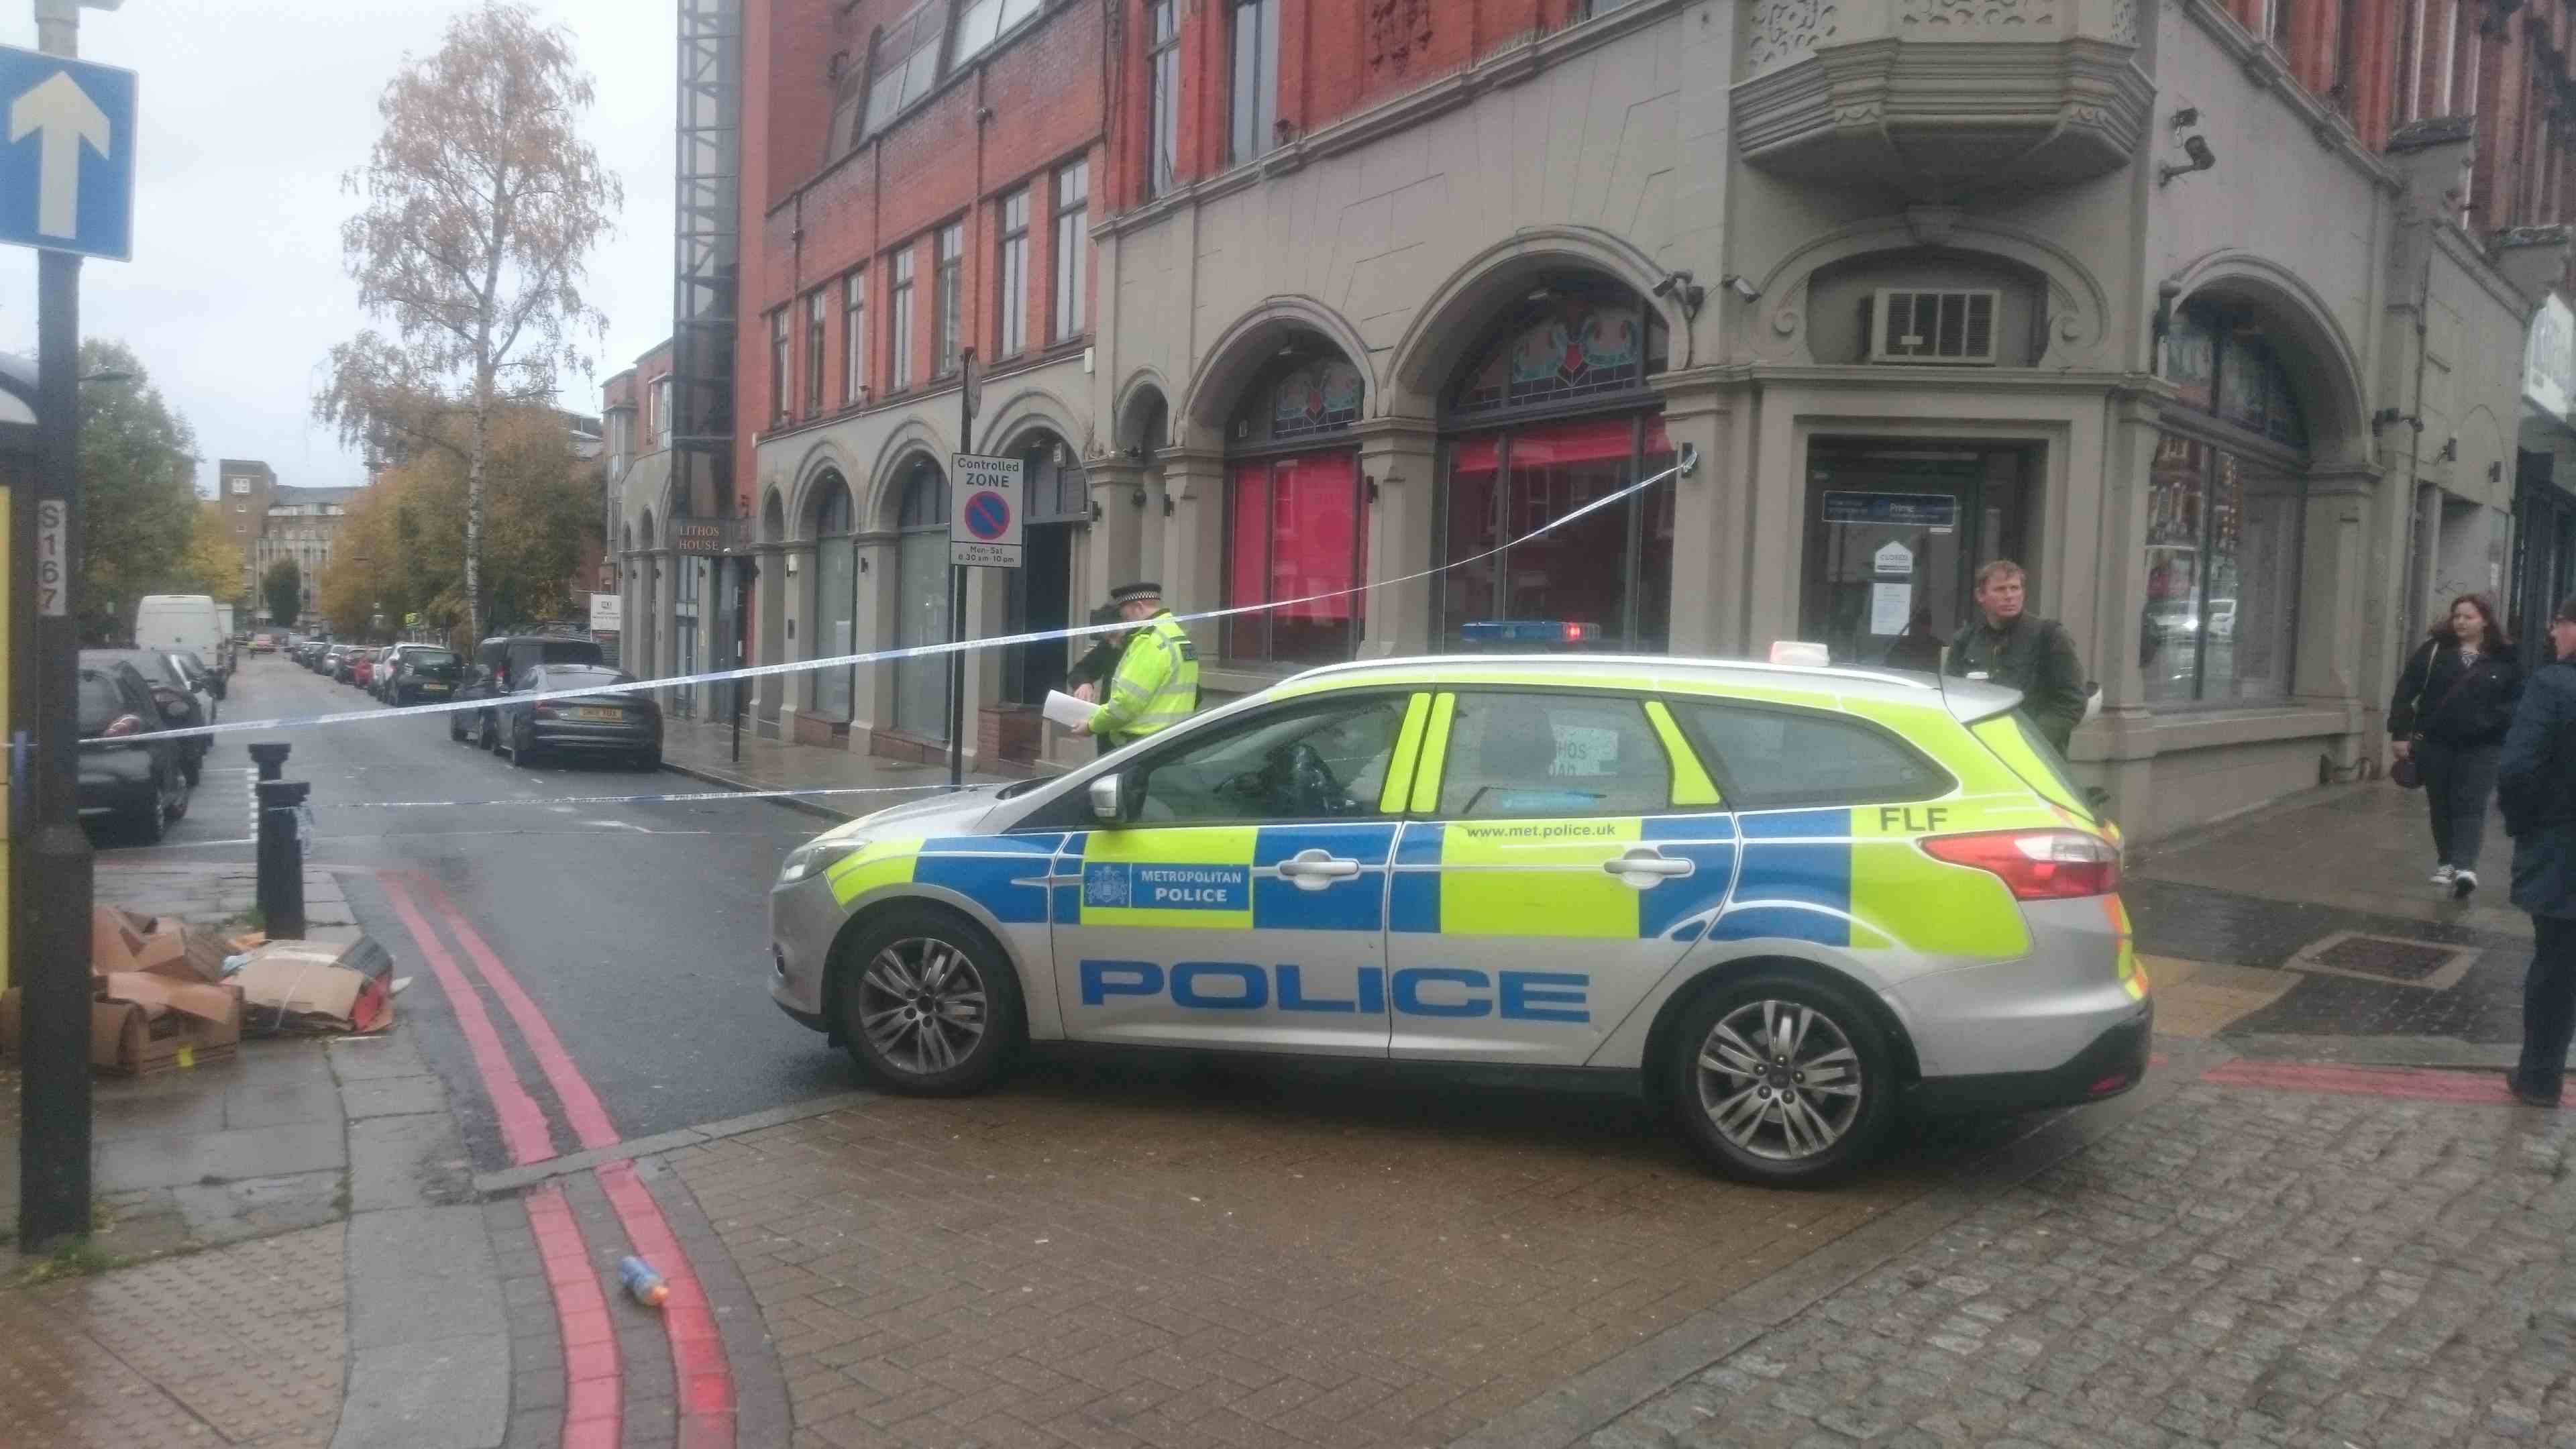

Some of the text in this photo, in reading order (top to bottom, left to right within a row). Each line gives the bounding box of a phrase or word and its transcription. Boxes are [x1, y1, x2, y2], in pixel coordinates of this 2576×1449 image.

[958, 458, 1019, 472] Controlled
[966, 473, 1010, 488] ZONE
[679, 525, 720, 537] LITHOS
[679, 539, 720, 550] HOUSE
[42, 504, 60, 610] S167
[1556, 741, 1588, 760] HOS
[1880, 807, 1948, 832] FLF
[1466, 823, 1616, 839] www.met.police.uk
[1141, 870, 1242, 883] METROPOLITAN
[1155, 887, 1228, 902] POLICE
[1079, 959, 1591, 1023] POLICE
